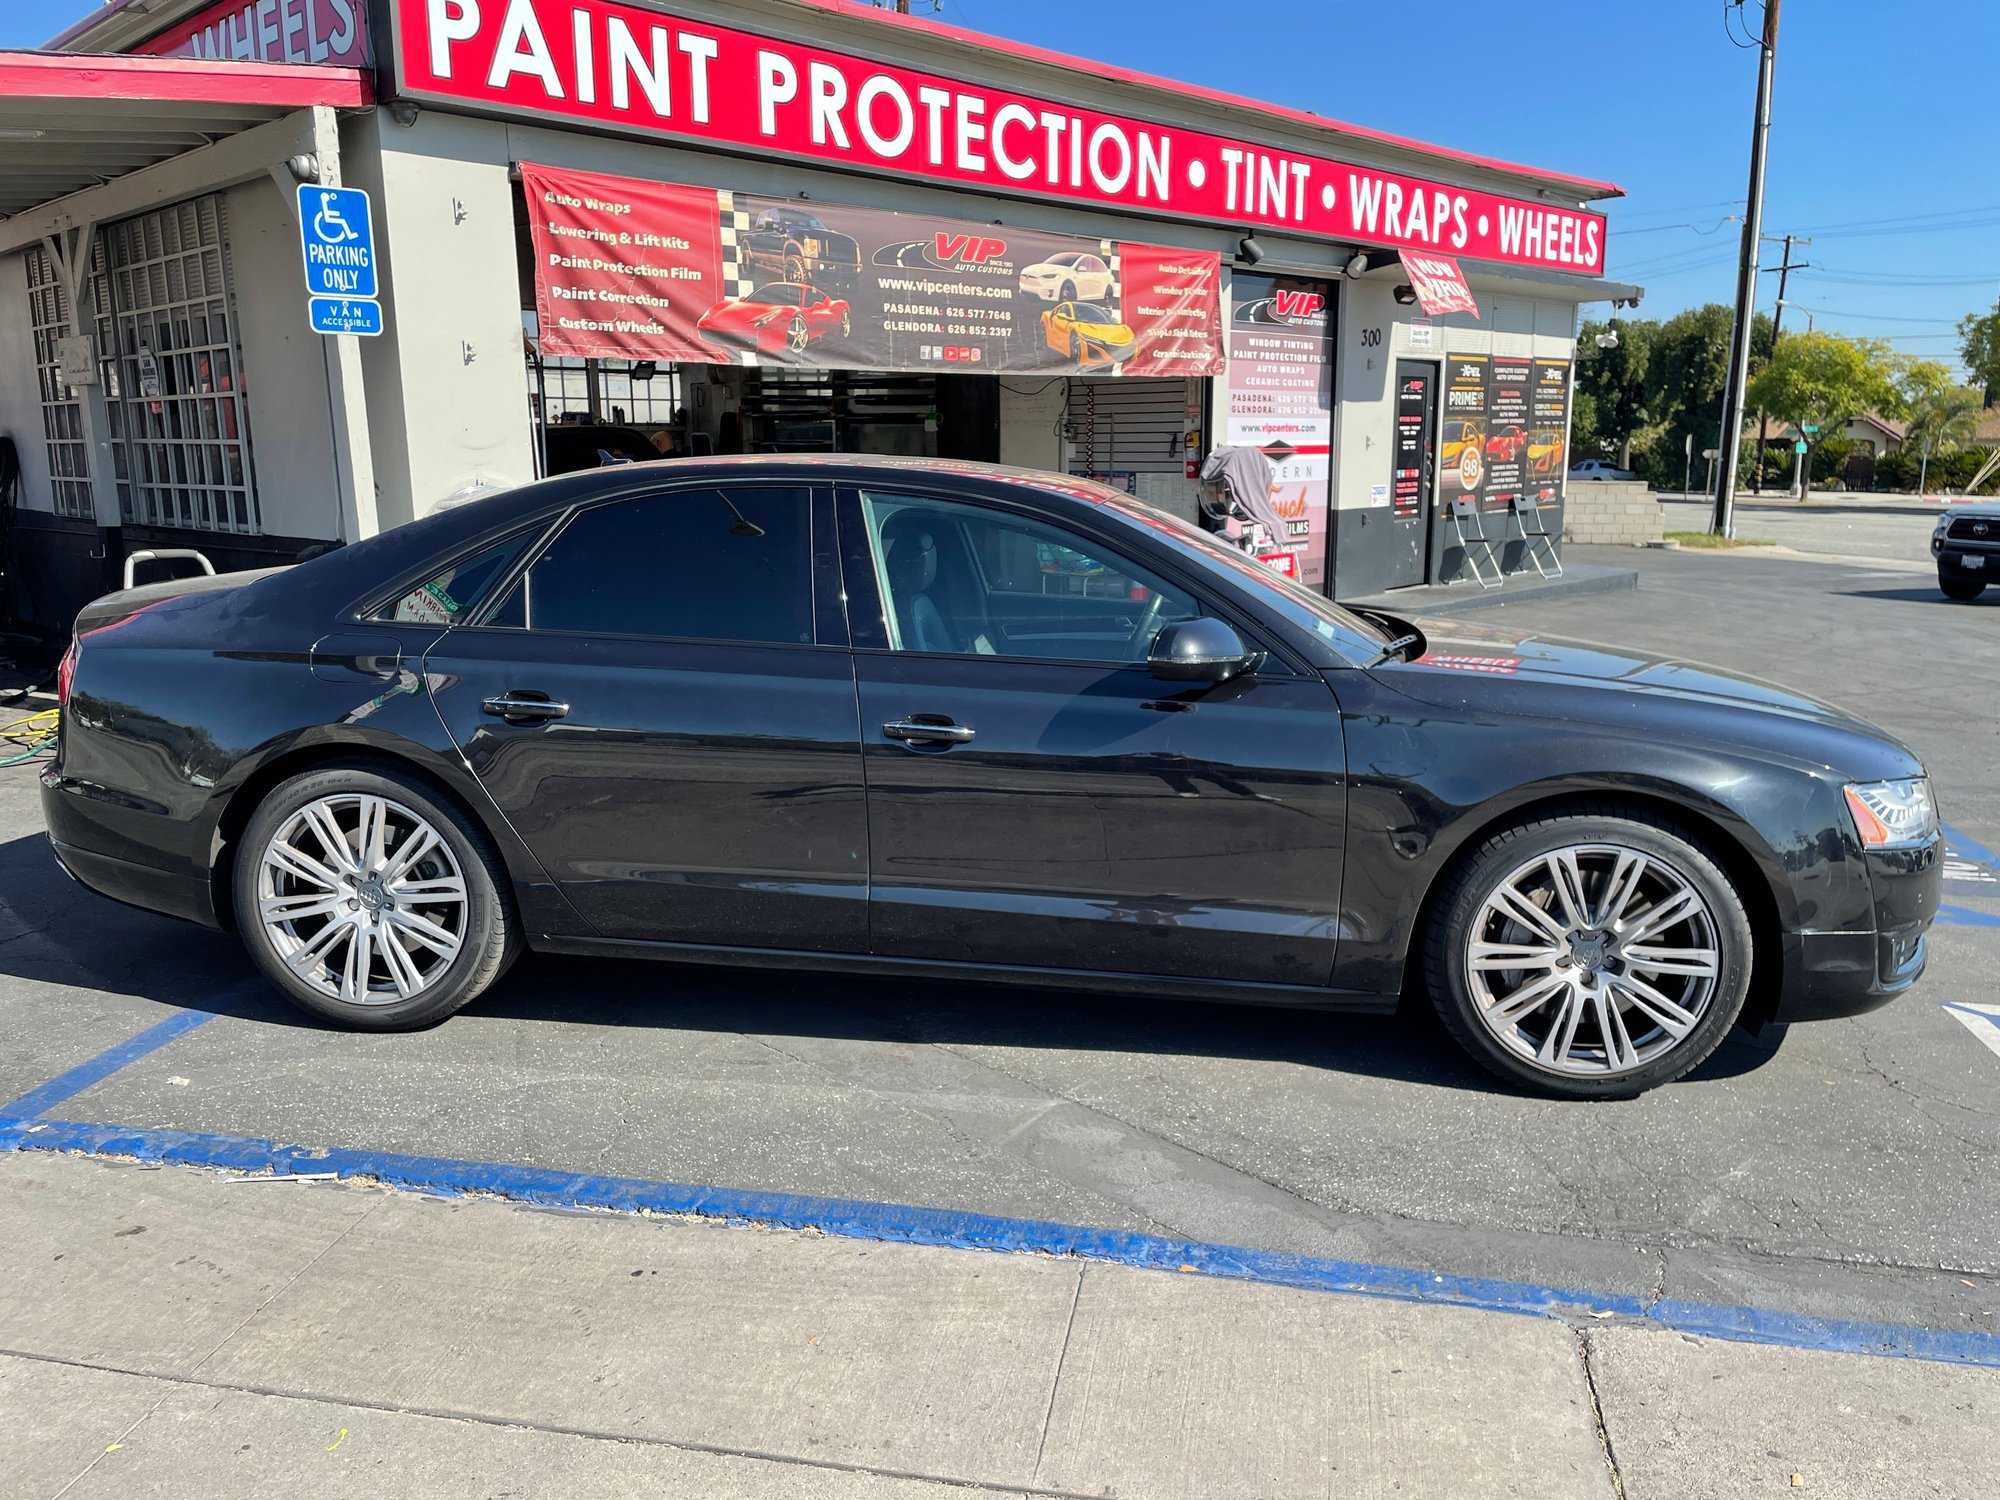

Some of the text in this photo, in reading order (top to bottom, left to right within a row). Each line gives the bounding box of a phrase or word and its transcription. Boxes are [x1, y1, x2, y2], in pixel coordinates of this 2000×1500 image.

[191, 0, 356, 63] WHEELS
[430, 0, 1600, 267] PAINT PROTECTION TINT WRAPS WHEELS
[544, 190, 631, 215] Auto Wraps
[548, 221, 690, 251] Lowering & Lift Kits
[308, 243, 369, 268] PARKING
[935, 232, 1007, 263] VIP
[549, 253, 701, 281] Paint Protection Film
[954, 263, 1014, 276] AUTO CUSTOMS
[1159, 264, 1177, 274] Auto
[1412, 257, 1457, 278] NOW
[323, 268, 359, 290] ONLY
[878, 277, 1012, 299] www.vipcenters.com
[552, 286, 669, 308] Paint Correction
[1276, 289, 1325, 318] VIP
[329, 305, 362, 318] VAN
[883, 303, 1011, 320] PASADENA: 626.577.7648
[322, 317, 372, 328] ACCESSIBLE
[559, 316, 665, 335] Custom Wheels
[883, 321, 1012, 337] GLENDORA: 626.852.2397
[1248, 338, 1314, 350] WINDOW TINTING
[1361, 328, 1381, 347] 300
[1233, 350, 1258, 360] PAINT
[1260, 351, 1308, 362] PROTECTION
[1257, 364, 1305, 375] AUTO WRAPS
[1245, 376, 1315, 388] CERAMIC COATING
[1232, 394, 1275, 403] PASADENA:
[1449, 391, 1477, 406] PRIME
[1231, 405, 1275, 414] GLENDORA:
[1241, 423, 1317, 435] www.vipcenters.com
[1270, 465, 1313, 478] DERN
[1463, 459, 1478, 476] 98
[1286, 521, 1309, 535] ILMS
